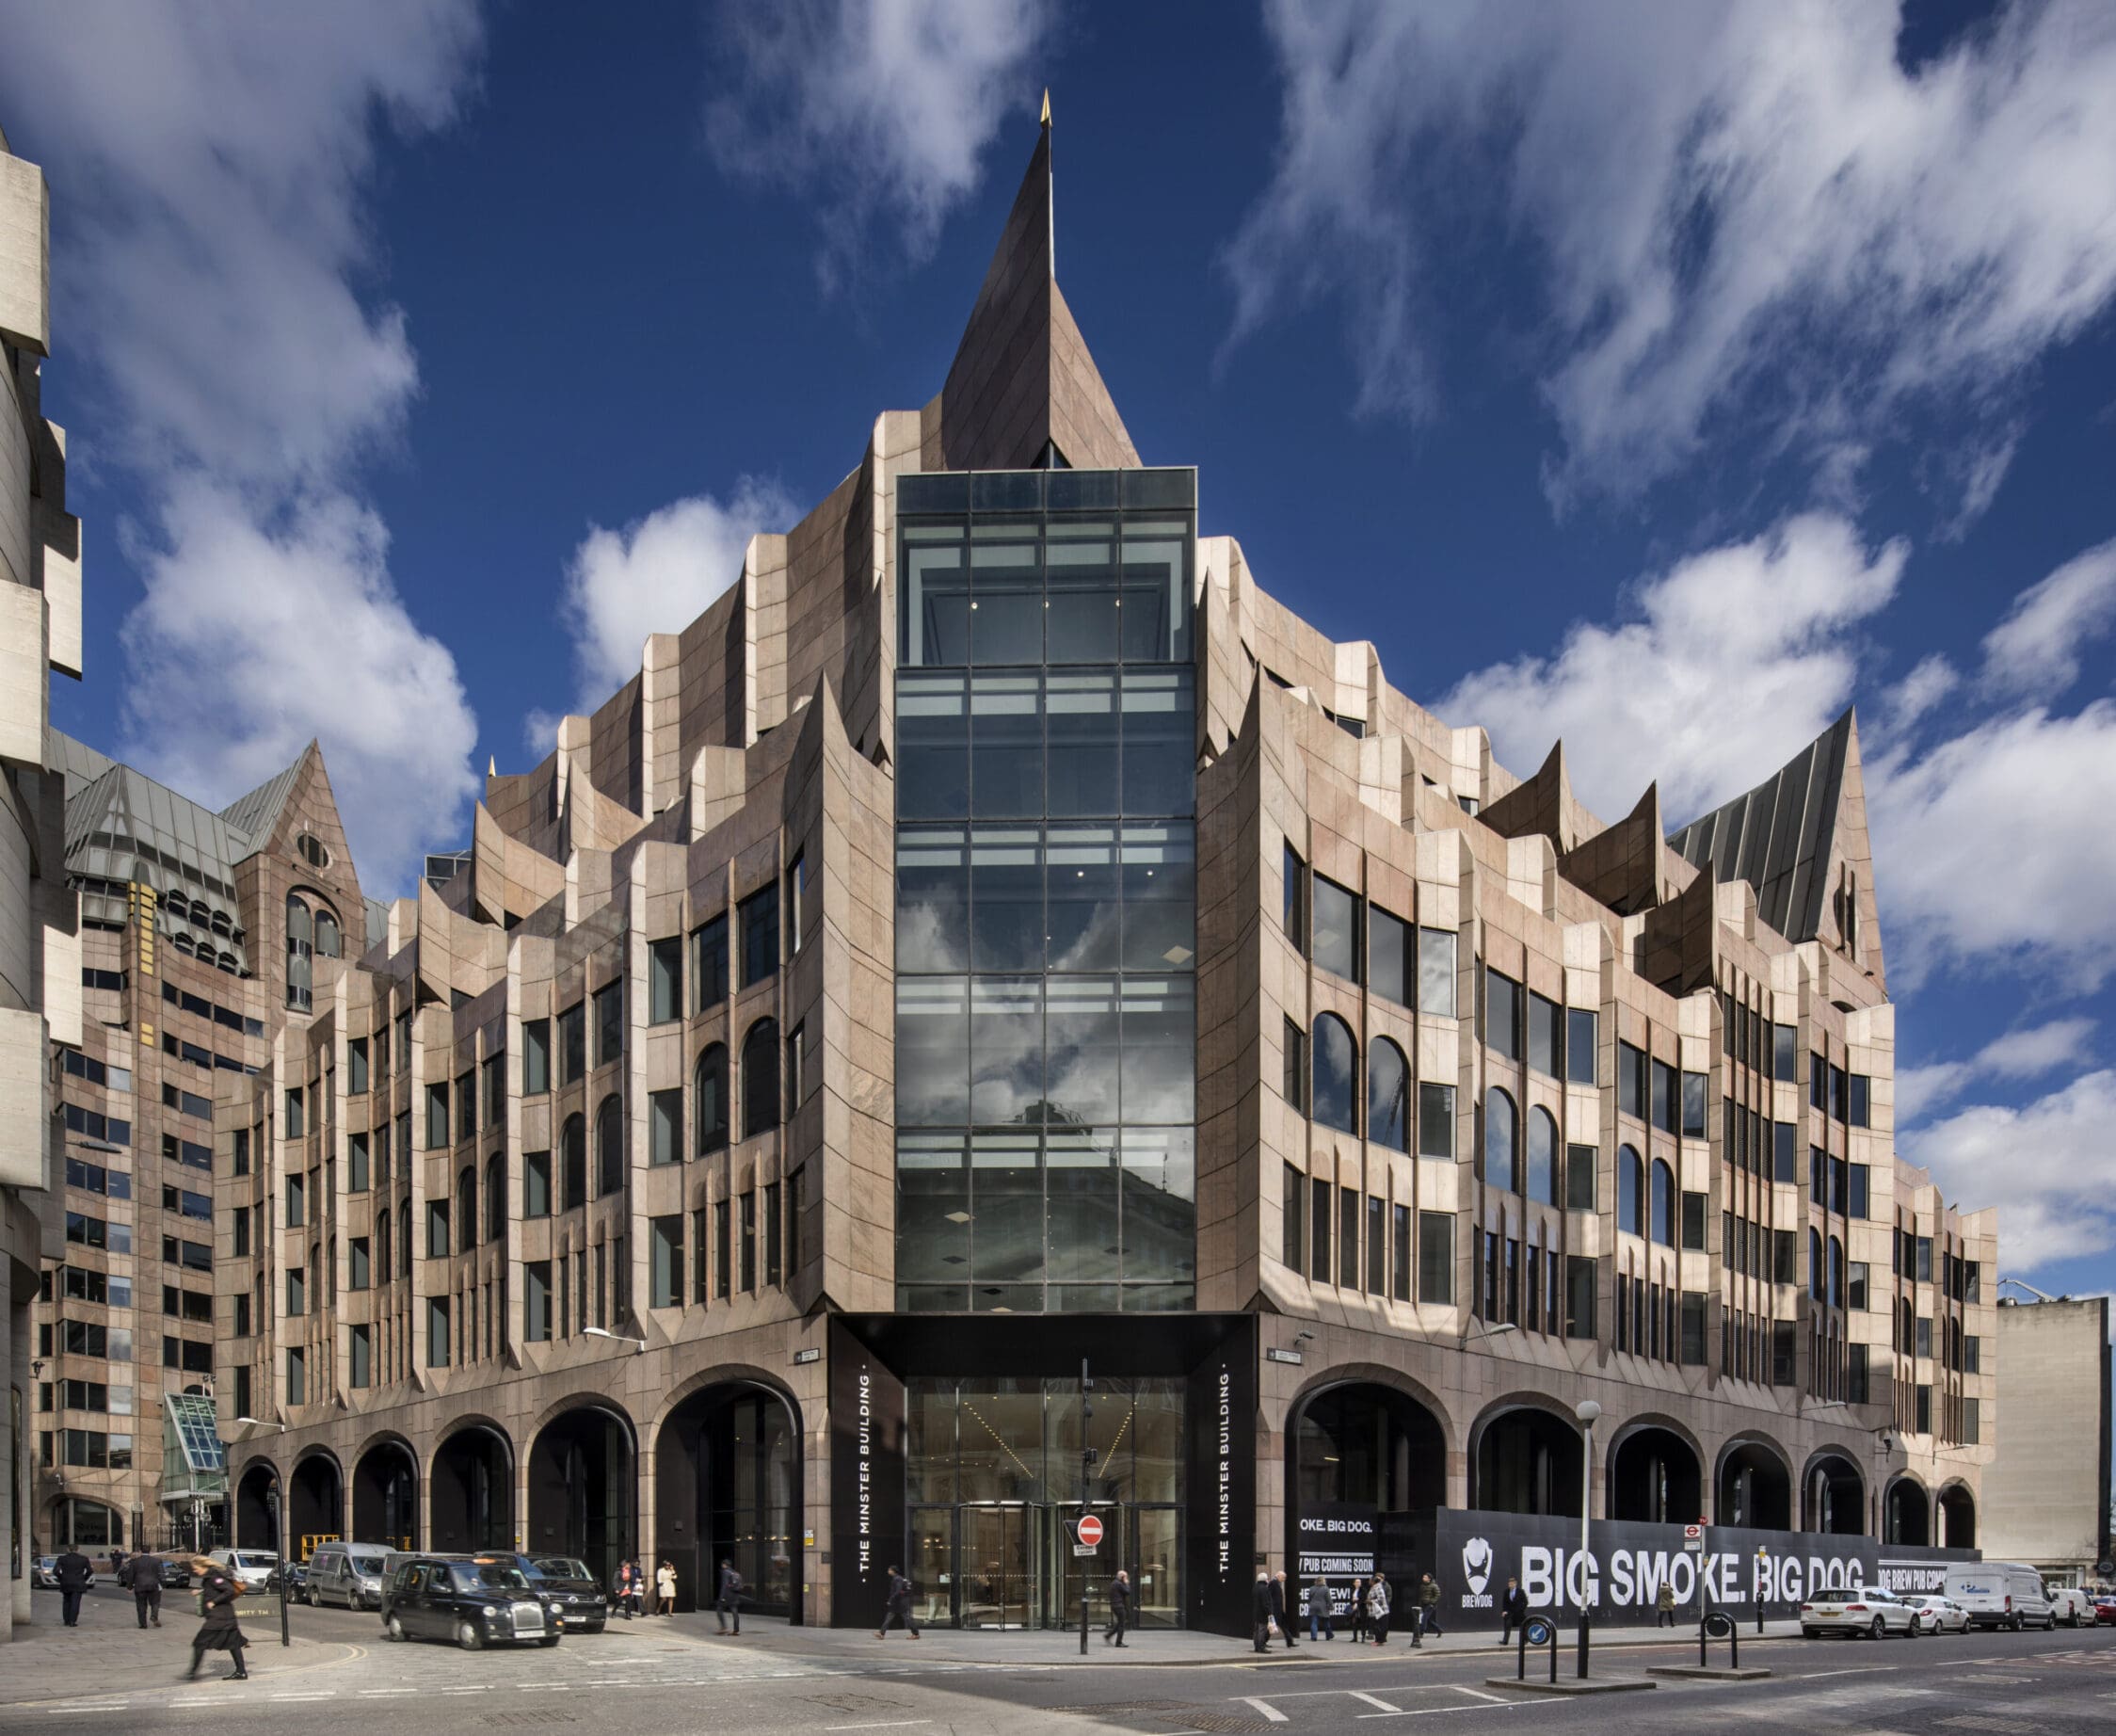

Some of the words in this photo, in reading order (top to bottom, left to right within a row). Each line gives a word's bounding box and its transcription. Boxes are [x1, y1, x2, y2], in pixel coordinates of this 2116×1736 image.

[859, 1374, 870, 1455] BUILDING
[1220, 1374, 1229, 1455] BUILDING
[859, 1461, 870, 1534] MINSTER
[1220, 1461, 1229, 1534] MINSTER
[1300, 1519, 1325, 1531] OKE.
[1327, 1519, 1346, 1532] BIG
[1347, 1521, 1372, 1533] DOG.
[859, 1540, 870, 1572] THE
[1220, 1540, 1229, 1572] THE
[1303, 1558, 1320, 1572] PUB
[1321, 1558, 1353, 1572] COMING
[1354, 1558, 1373, 1572] SOON
[1522, 1546, 1599, 1607] BIG
[1610, 1549, 1746, 1605] SMOKE.
[1753, 1553, 1803, 1602] BIG
[1807, 1556, 1864, 1600] DOG
[1892, 1568, 1913, 1590] BREW
[1913, 1569, 1926, 1590] PUB
[1462, 1594, 1493, 1608] BREWDOG
